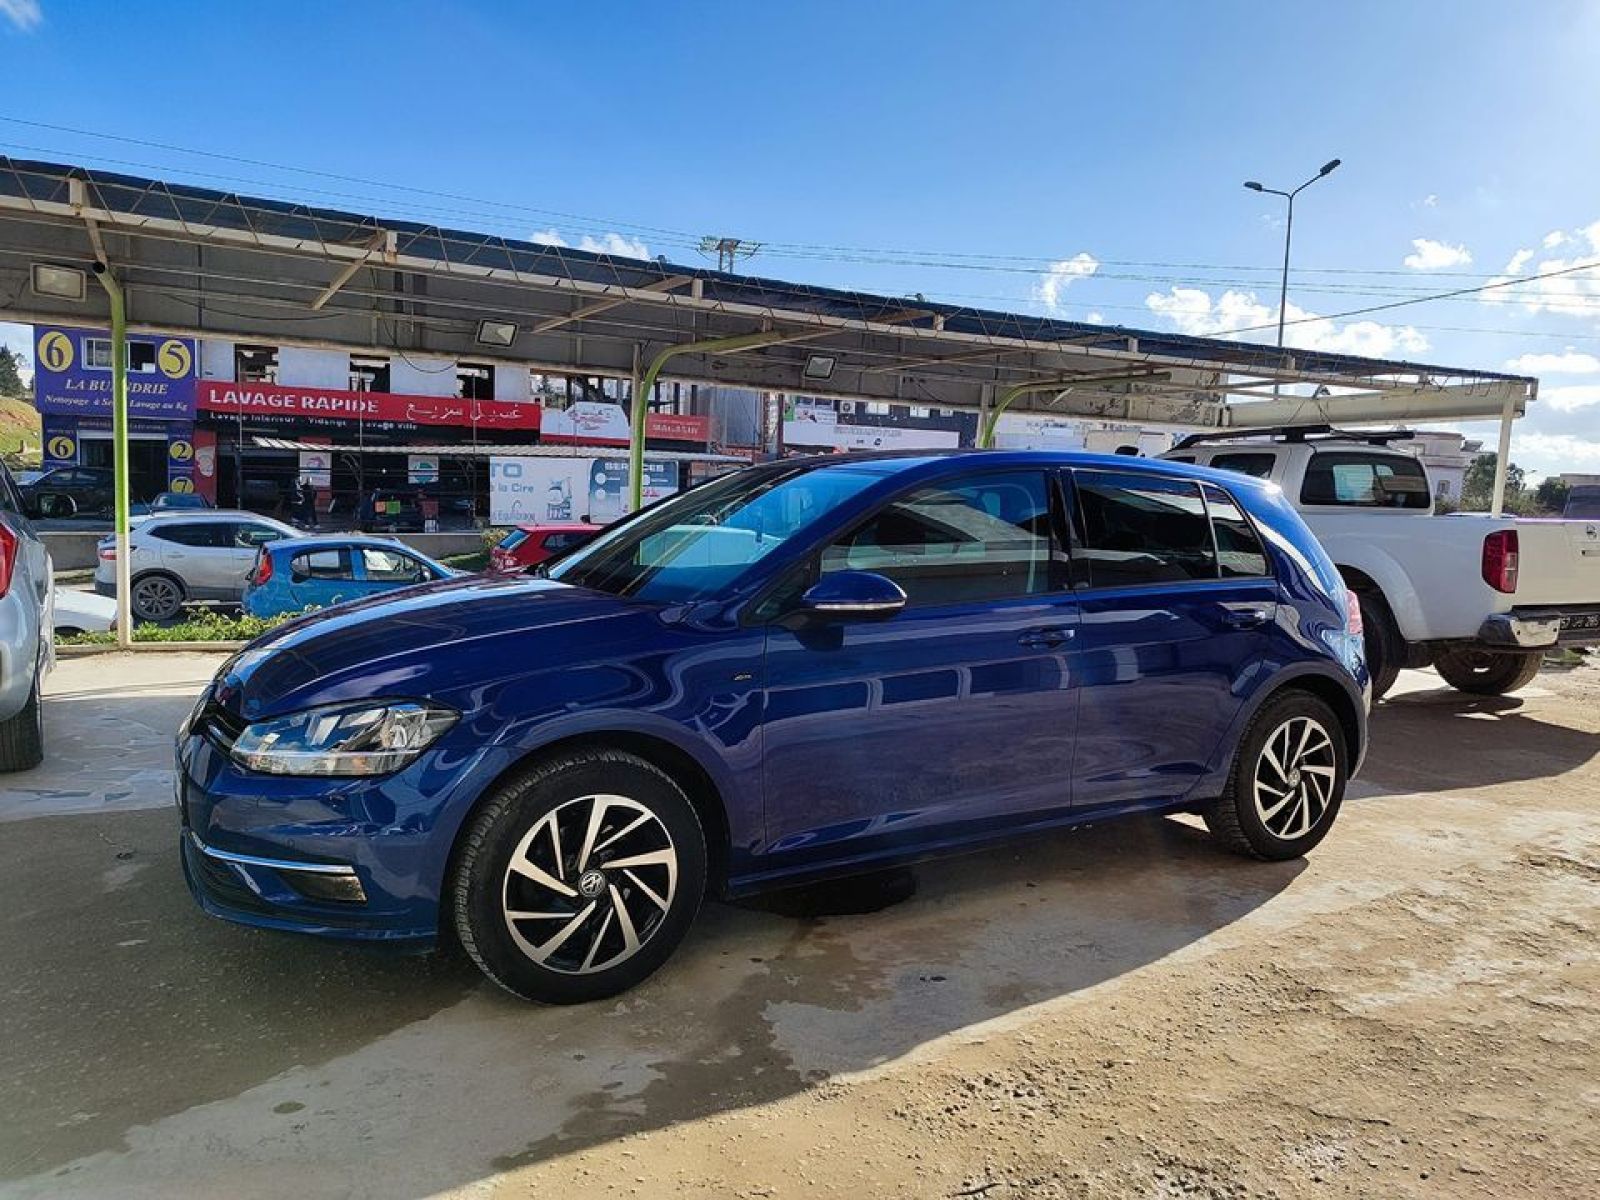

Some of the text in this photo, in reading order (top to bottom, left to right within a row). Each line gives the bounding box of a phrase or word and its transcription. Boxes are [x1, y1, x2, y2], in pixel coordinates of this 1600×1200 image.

[46, 335, 64, 368] 6
[164, 344, 184, 374] 5
[65, 378, 168, 395] LA BUDRIE
[209, 389, 379, 413] LAVAGE RAPIDE
[54, 437, 69, 456] 6
[176, 443, 186, 459] 2
